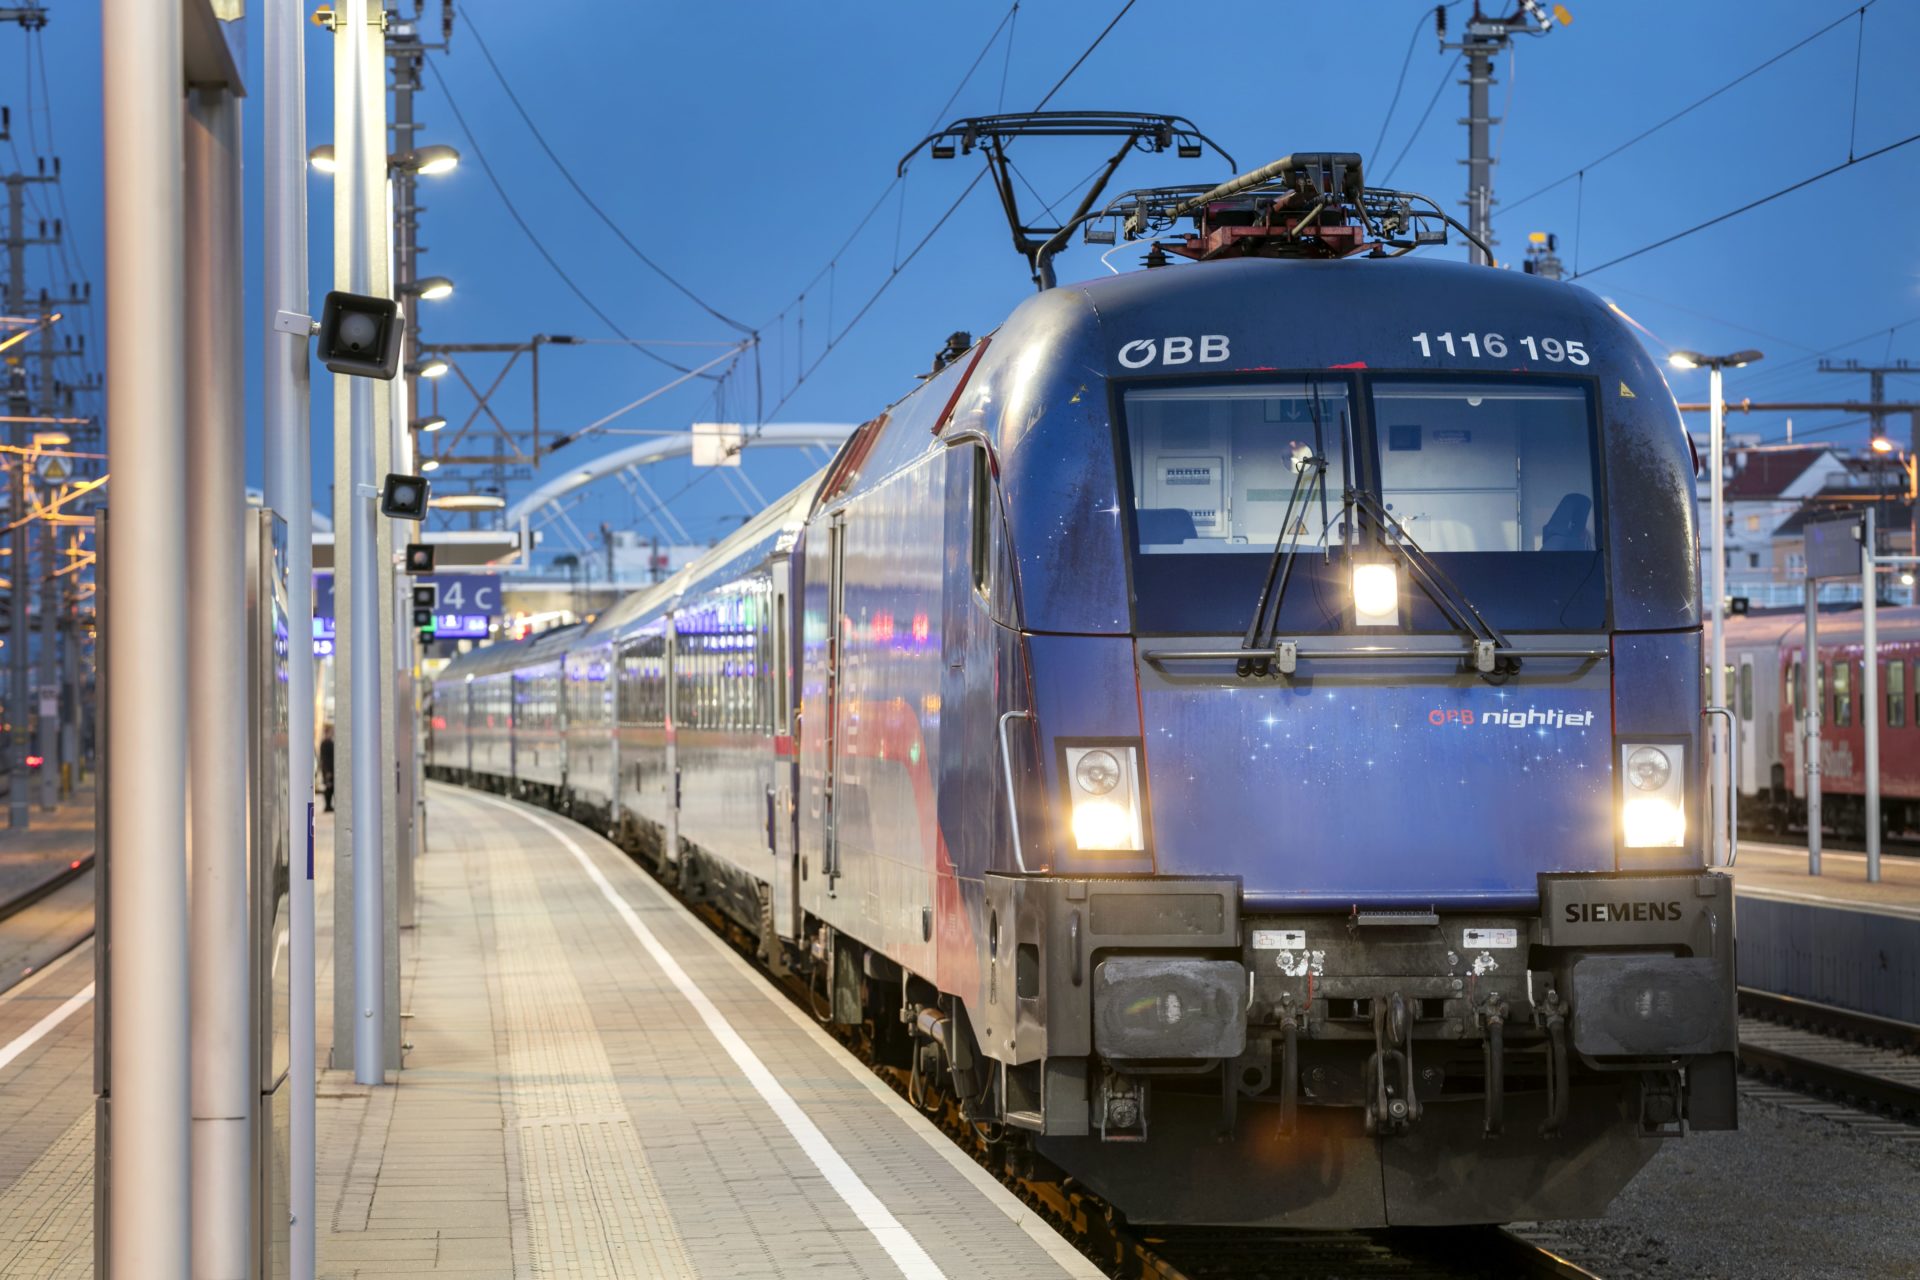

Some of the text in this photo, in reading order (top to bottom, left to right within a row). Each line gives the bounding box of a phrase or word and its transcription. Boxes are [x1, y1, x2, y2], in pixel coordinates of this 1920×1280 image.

[1118, 334, 1231, 369] ÖBB
[1412, 332, 1590, 366] 1116 195
[1482, 708, 1595, 729] nightjet
[1565, 901, 1682, 923] SIEMENS
